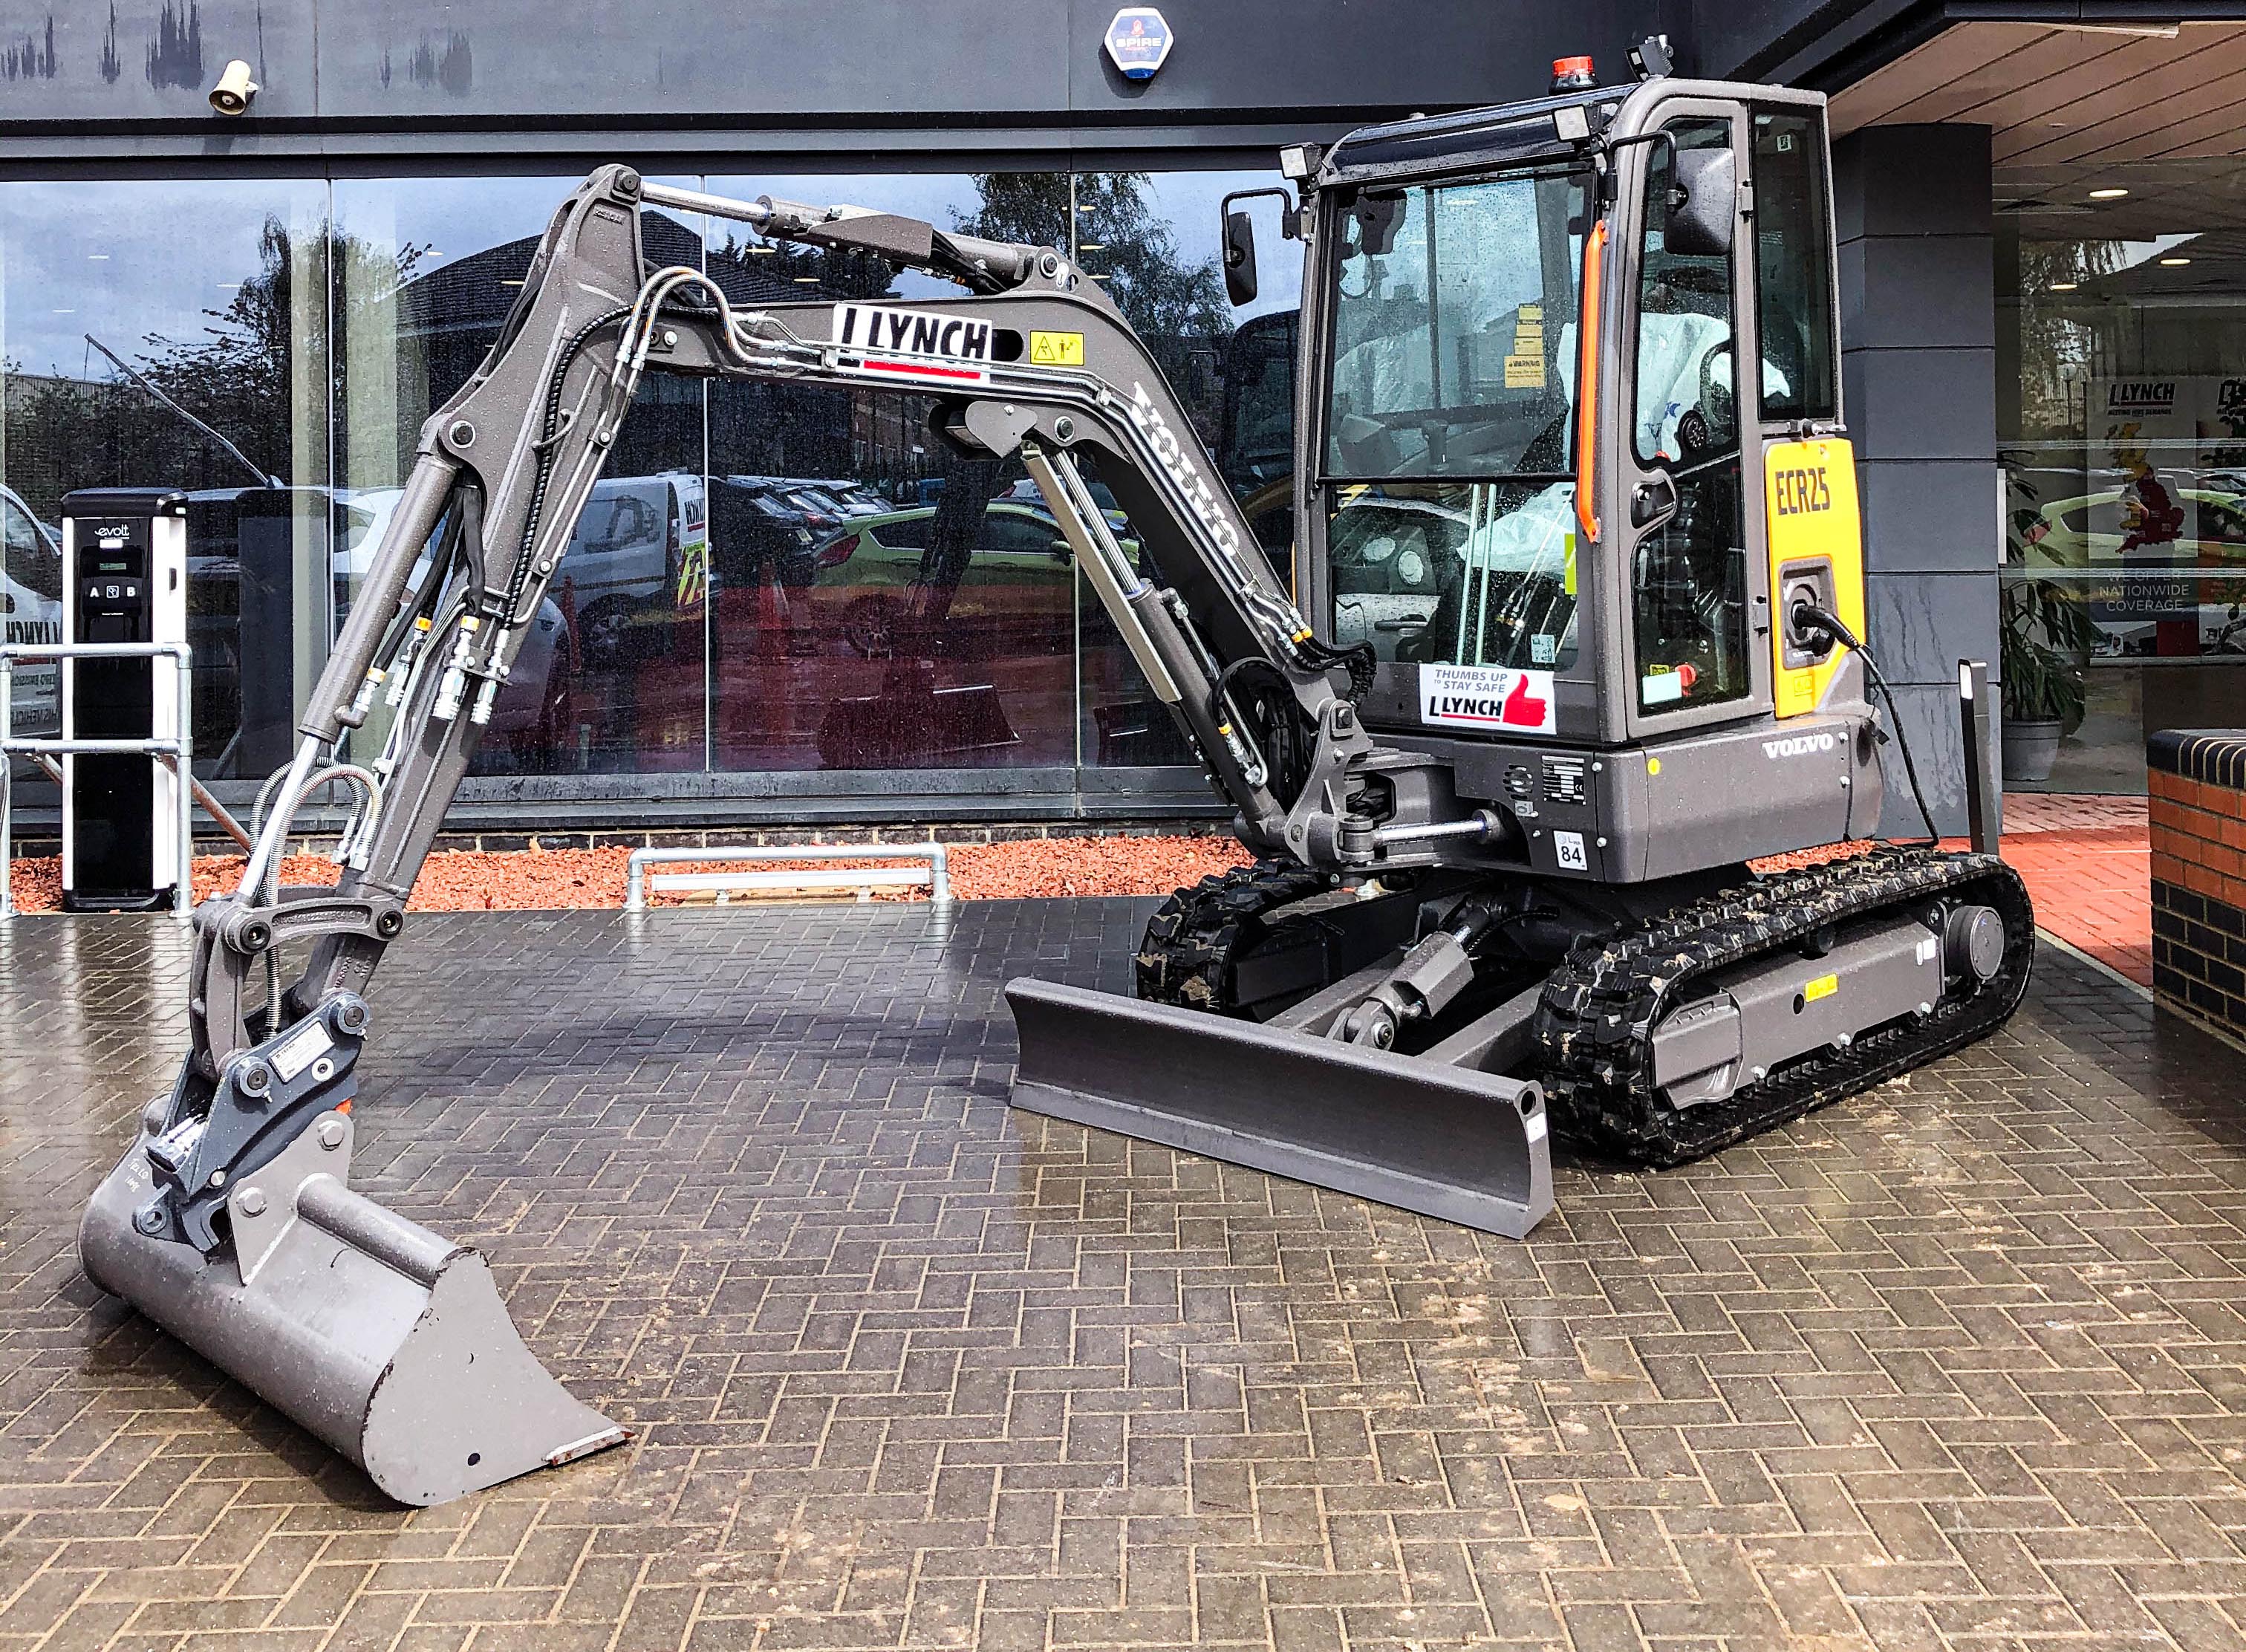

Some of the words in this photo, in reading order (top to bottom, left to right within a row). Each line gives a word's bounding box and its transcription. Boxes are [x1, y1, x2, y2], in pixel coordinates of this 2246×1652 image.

[1116, 37, 1162, 48] SPIRE
[1131, 380, 1239, 557] VOLVO
[1775, 466, 1831, 516] ECR25
[94, 524, 130, 536] evolt
[90, 587, 100, 597] A
[126, 586, 136, 596] B
[2099, 584, 2190, 596] NATIONWIDE
[2106, 599, 2184, 612] COVERAGE
[1435, 669, 1486, 680] THUMBS
[1490, 673, 1508, 682] UP
[1443, 680, 1472, 691] STAY
[1474, 683, 1506, 693] SAFE
[1442, 697, 1503, 716] LYNCH
[1762, 732, 1834, 758] VOLVO
[1560, 845, 1582, 863] 84
